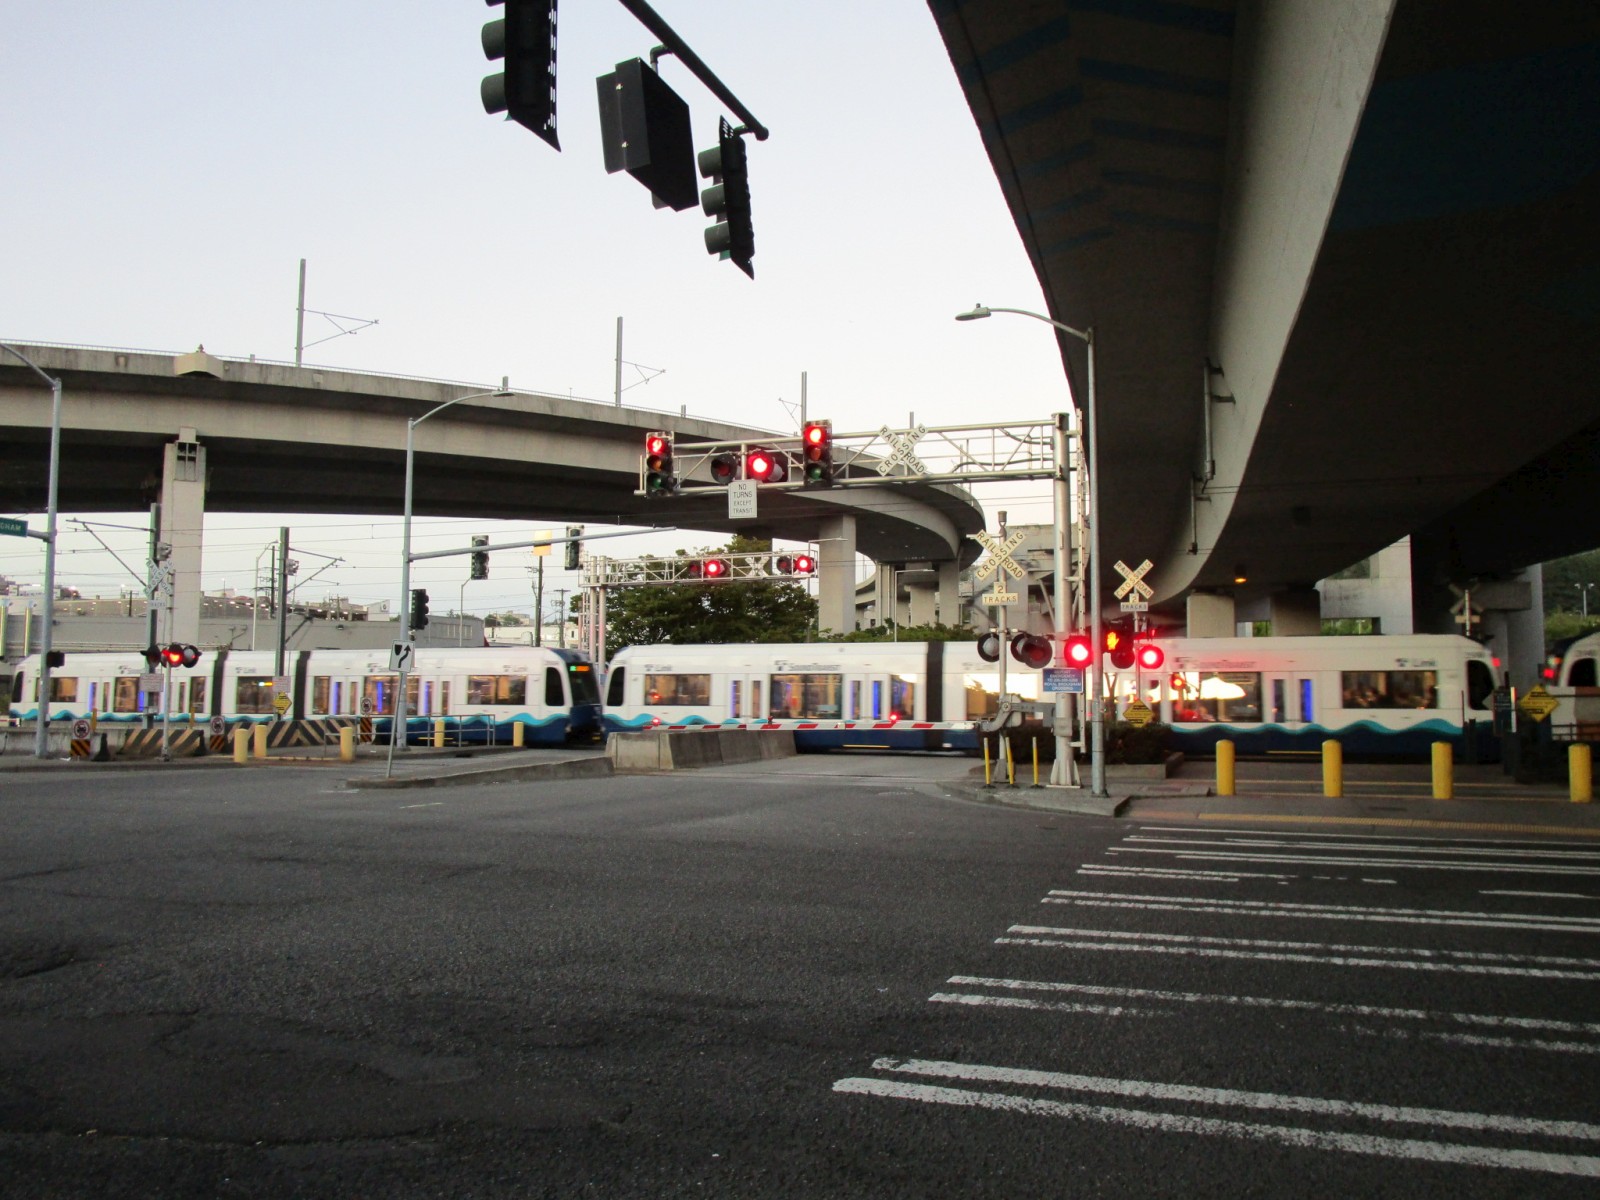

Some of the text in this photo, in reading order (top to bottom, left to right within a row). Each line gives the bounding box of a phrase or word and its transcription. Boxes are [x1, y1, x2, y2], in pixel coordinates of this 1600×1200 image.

[879, 426, 926, 474] CROSSING
[976, 532, 1024, 578] CROSSING
[998, 585, 1004, 593] 2
[1116, 561, 1151, 597] CROSSING
